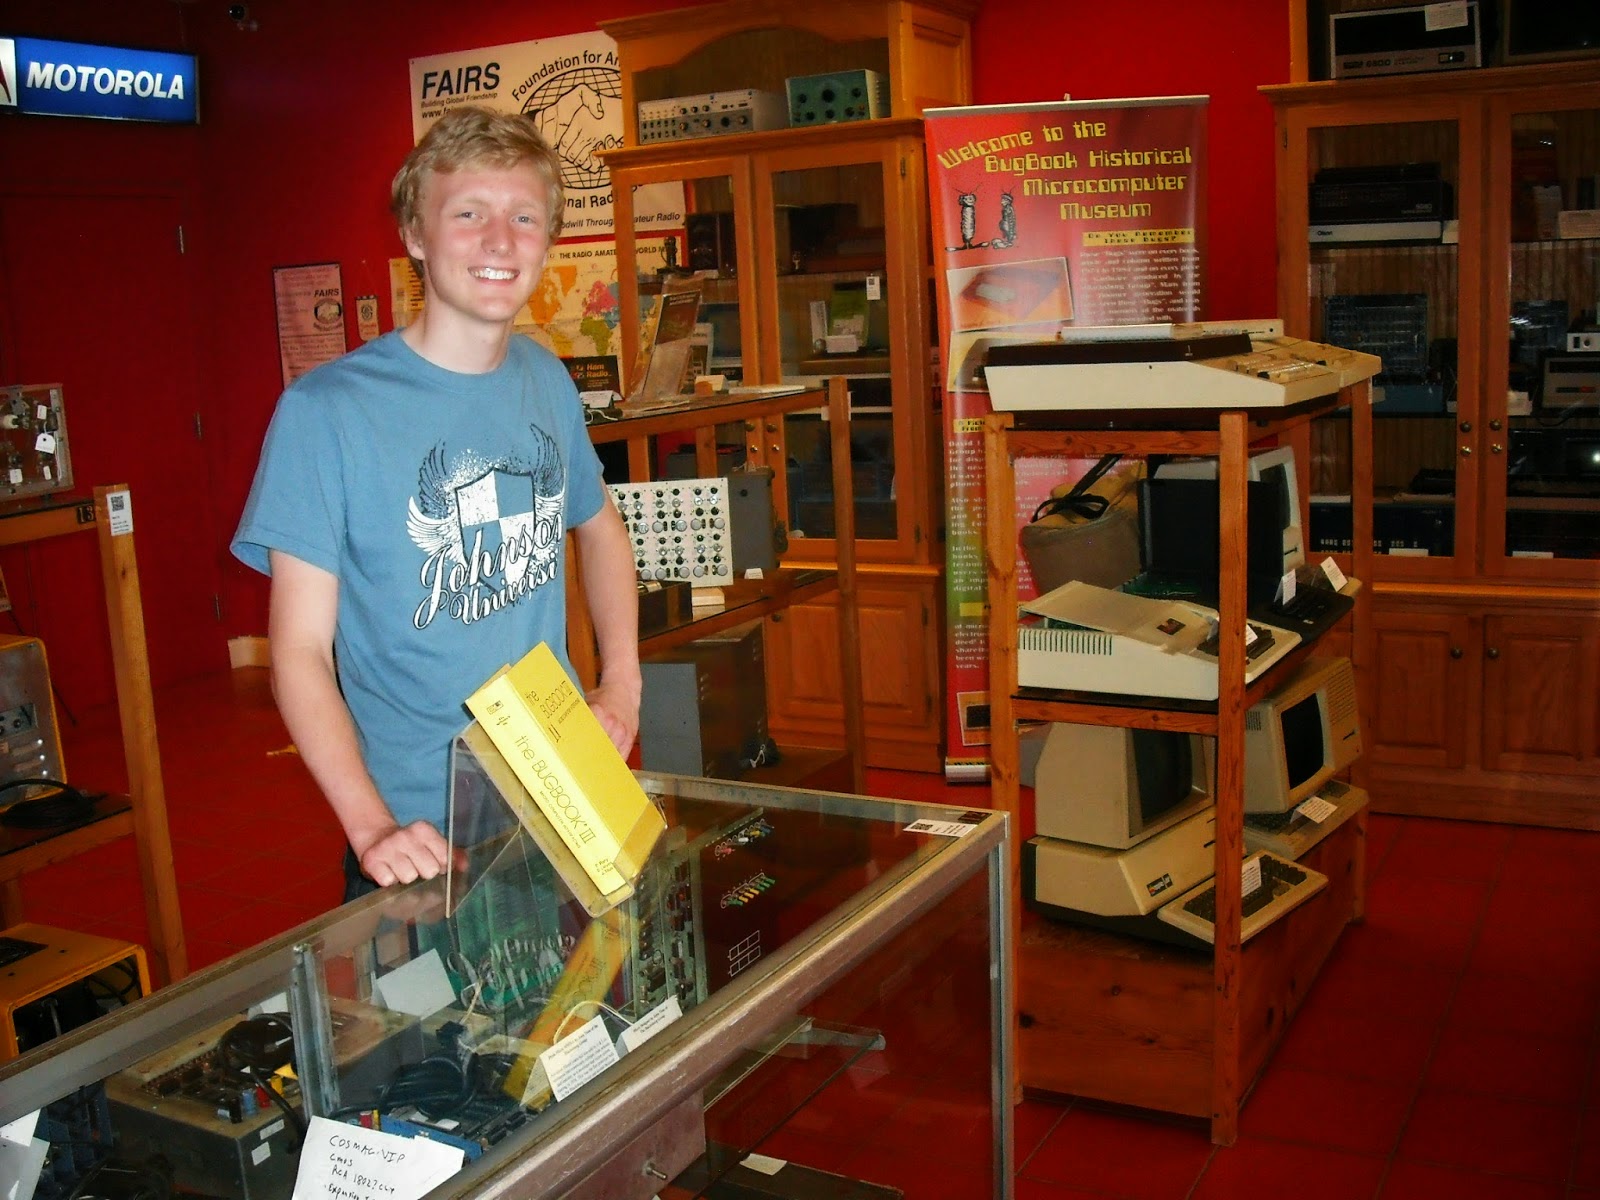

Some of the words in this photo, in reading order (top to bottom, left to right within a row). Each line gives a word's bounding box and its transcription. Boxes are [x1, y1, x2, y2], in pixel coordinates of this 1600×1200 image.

[26, 62, 184, 100] MOTOROLA
[422, 62, 500, 100] FAIRS
[512, 56, 580, 102] Foundation
[583, 50, 602, 64] for
[446, 94, 464, 105] Global
[466, 92, 498, 103] Friendship
[938, 130, 1033, 169] Welcome
[1042, 125, 1064, 142] to
[1073, 120, 1106, 139] the
[985, 152, 1078, 176] BugBook
[1089, 147, 1192, 168] Historical
[1024, 175, 1188, 196] Microcomputer
[656, 212, 681, 222] Radio
[1060, 202, 1152, 220] Museum
[314, 288, 340, 298] FAIRS
[586, 363, 604, 371] Ham
[78, 506, 94, 523] 13
[450, 551, 558, 626] Universi
[514, 735, 534, 761] the
[580, 828, 596, 845] III
